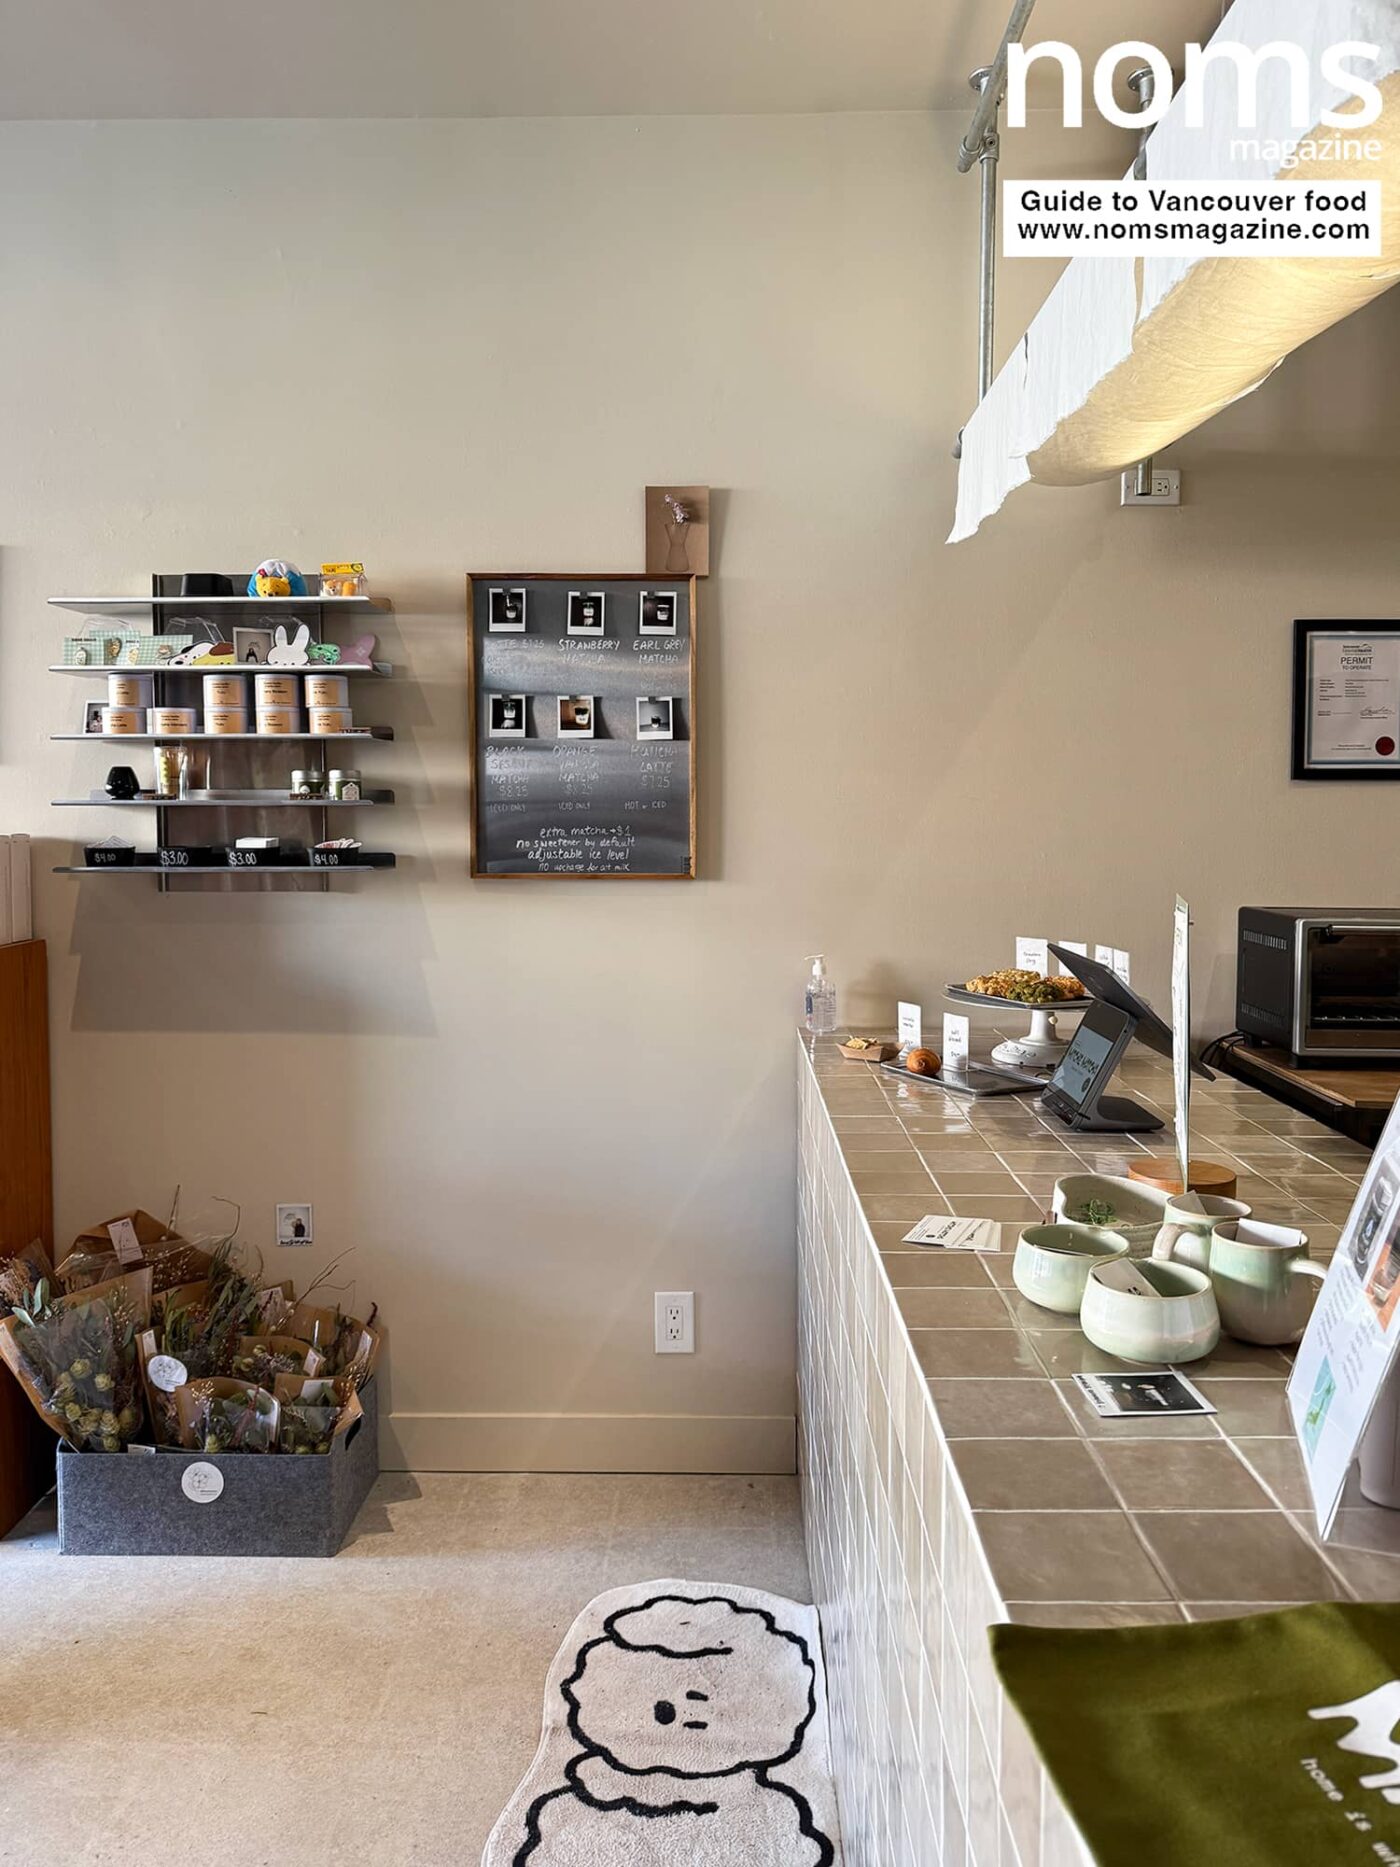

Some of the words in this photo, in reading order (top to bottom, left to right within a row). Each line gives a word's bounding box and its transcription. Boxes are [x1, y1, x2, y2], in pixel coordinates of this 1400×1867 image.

[633, 639, 660, 651] EARL
[663, 638, 686, 652] GREY
[639, 653, 679, 665] MATCHA
[1340, 656, 1373, 664] PERMIT
[540, 826, 568, 839] extra
[571, 824, 609, 837] matcha
[516, 839, 530, 850] no
[533, 839, 581, 848] sweetener
[585, 838, 596, 849] by
[600, 836, 636, 847] default
[159, 850, 189, 866] $3.00
[228, 850, 257, 866] $3.00
[313, 853, 339, 865] $4.00
[528, 848, 584, 863] adjustable
[589, 848, 602, 860] ice
[607, 847, 630, 861] level
[538, 862, 549, 872] no
[1299, 1757, 1344, 1802] home
[1343, 1810, 1372, 1832] is
